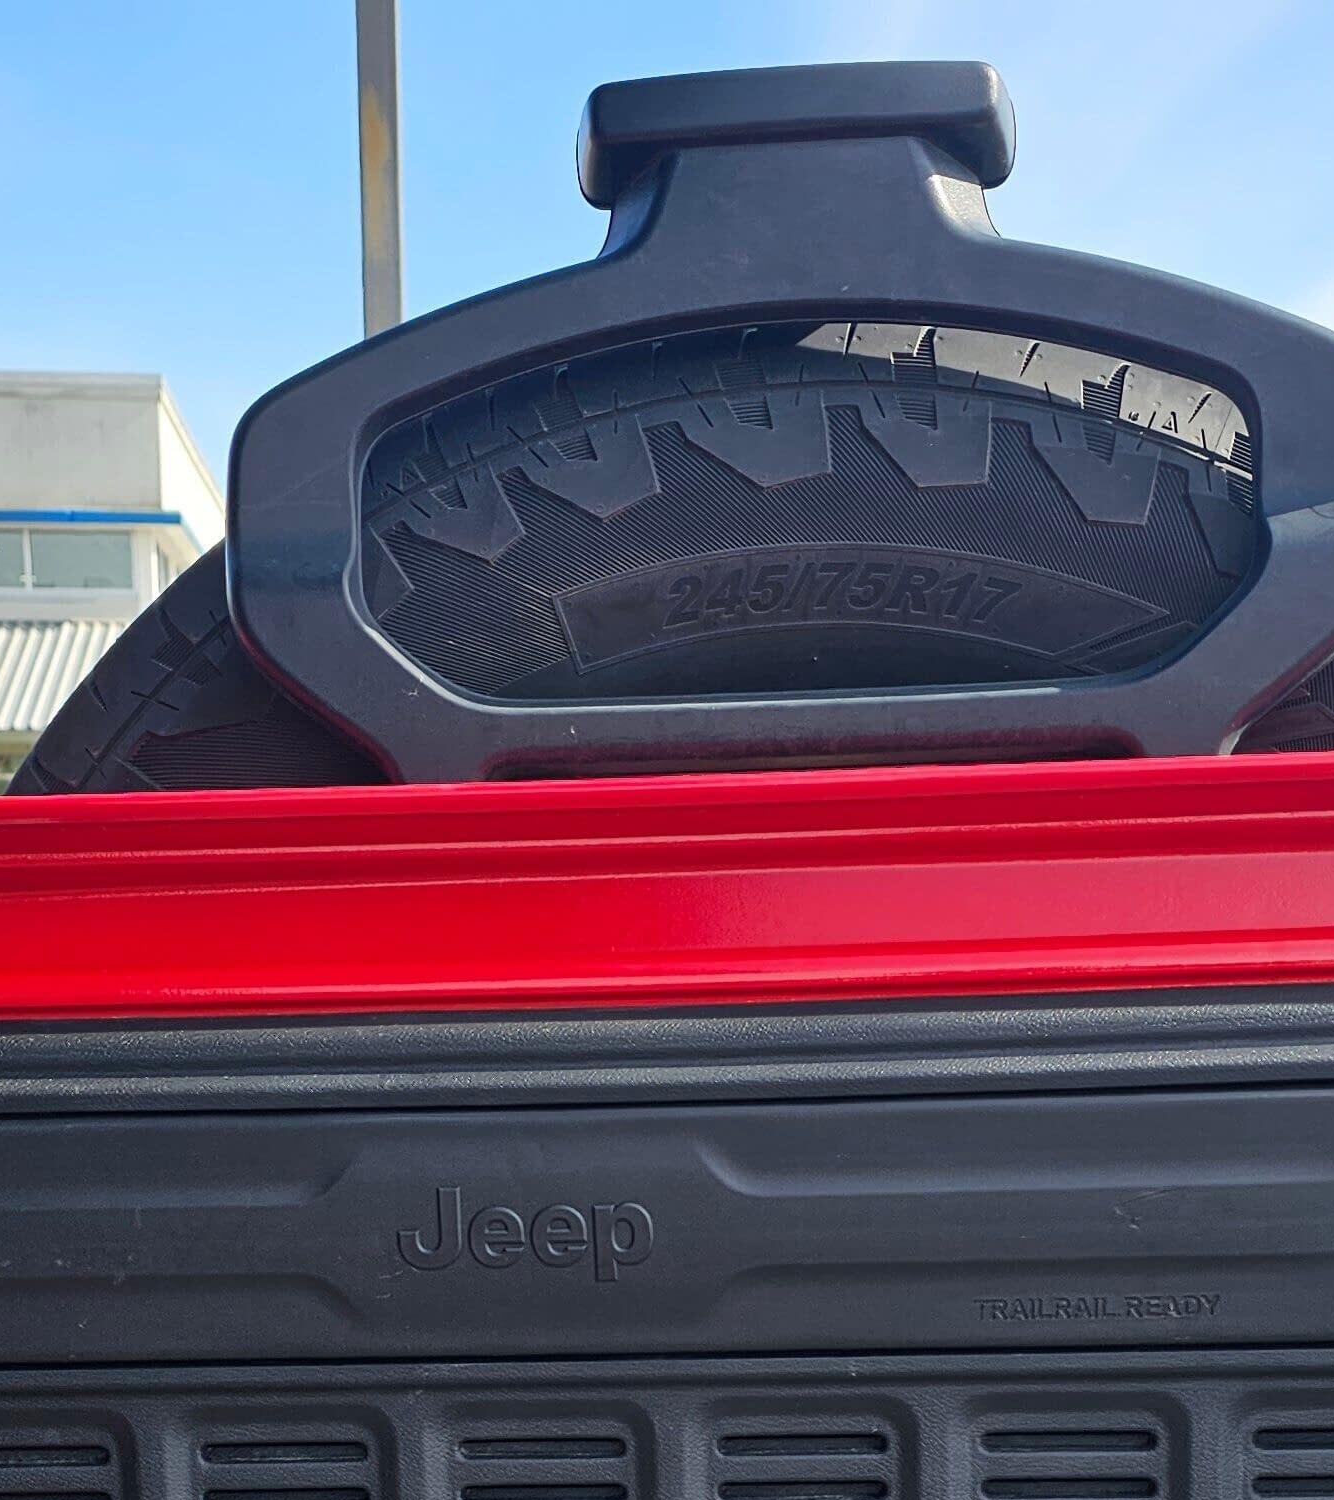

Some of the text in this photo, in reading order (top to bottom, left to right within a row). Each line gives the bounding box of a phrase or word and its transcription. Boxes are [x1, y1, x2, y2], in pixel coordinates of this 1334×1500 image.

[664, 559, 1025, 628] 245/75R17
[396, 1186, 655, 1282] Jeep
[1124, 1294, 1221, 1319] READY
